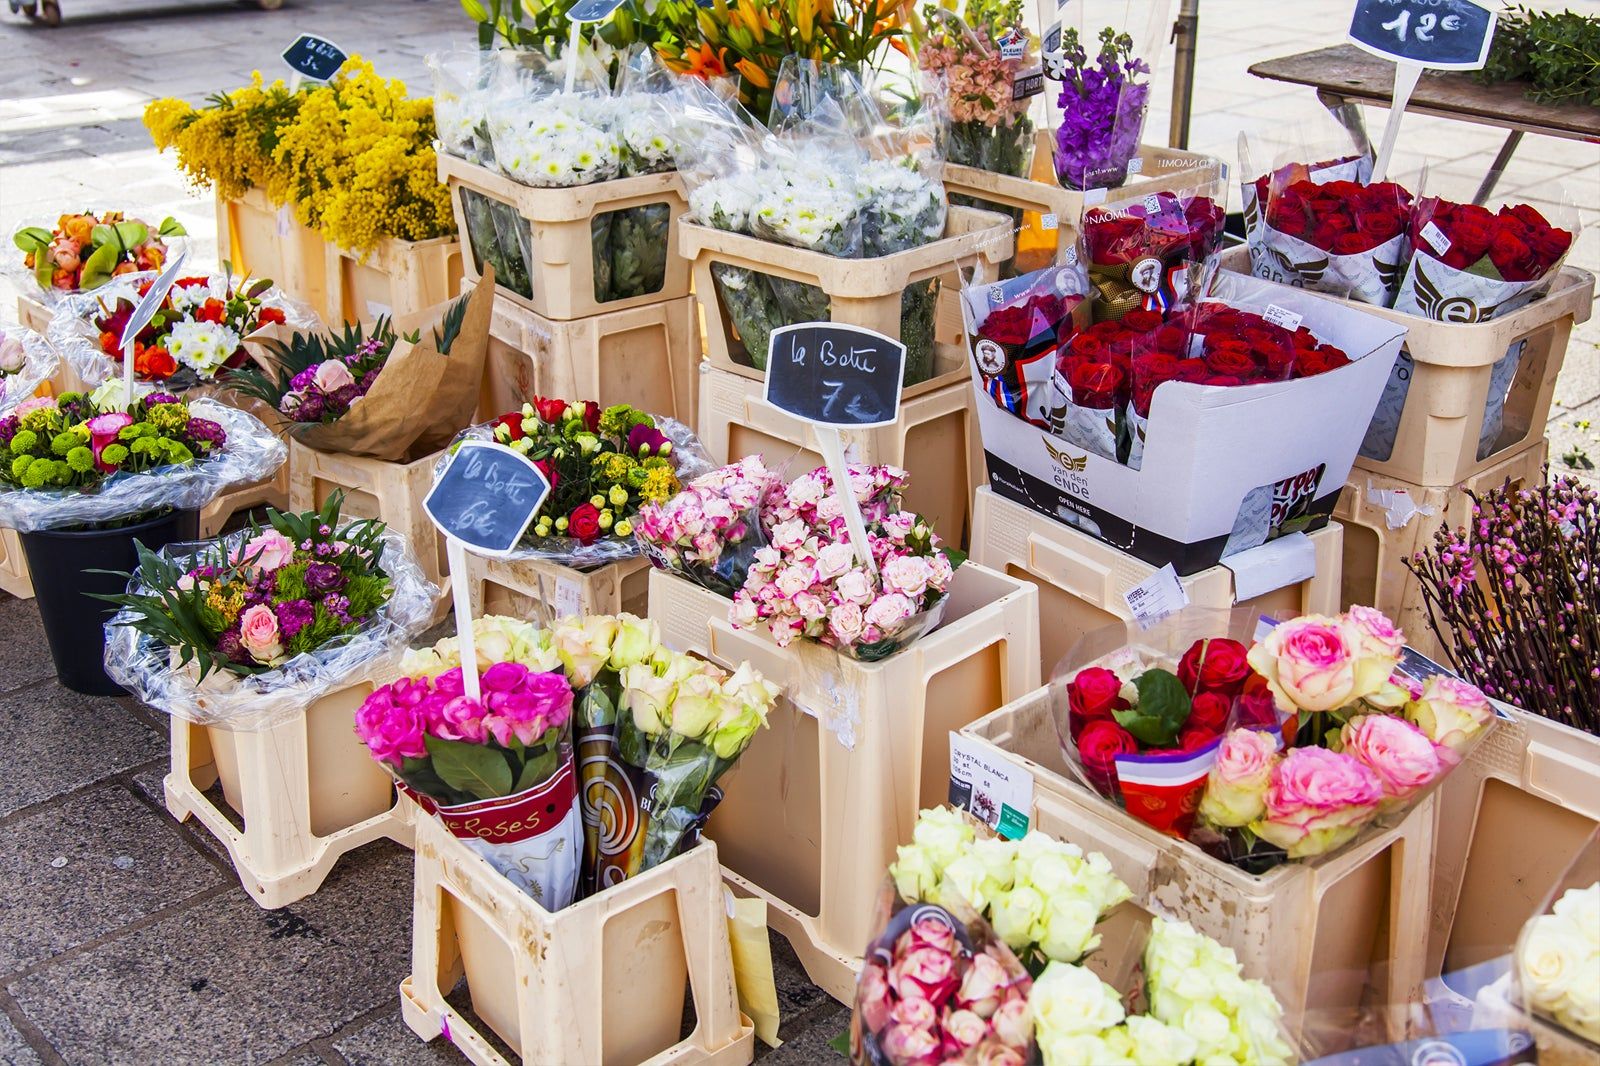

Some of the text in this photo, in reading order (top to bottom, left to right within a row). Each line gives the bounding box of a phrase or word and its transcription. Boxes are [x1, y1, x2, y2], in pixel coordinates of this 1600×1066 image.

[1089, 207, 1130, 225] NAOMI!
[1051, 464, 1088, 487] van den
[1058, 496, 1092, 517] OPEN HERE
[953, 748, 1009, 782] CRYSTAL BLANCA
